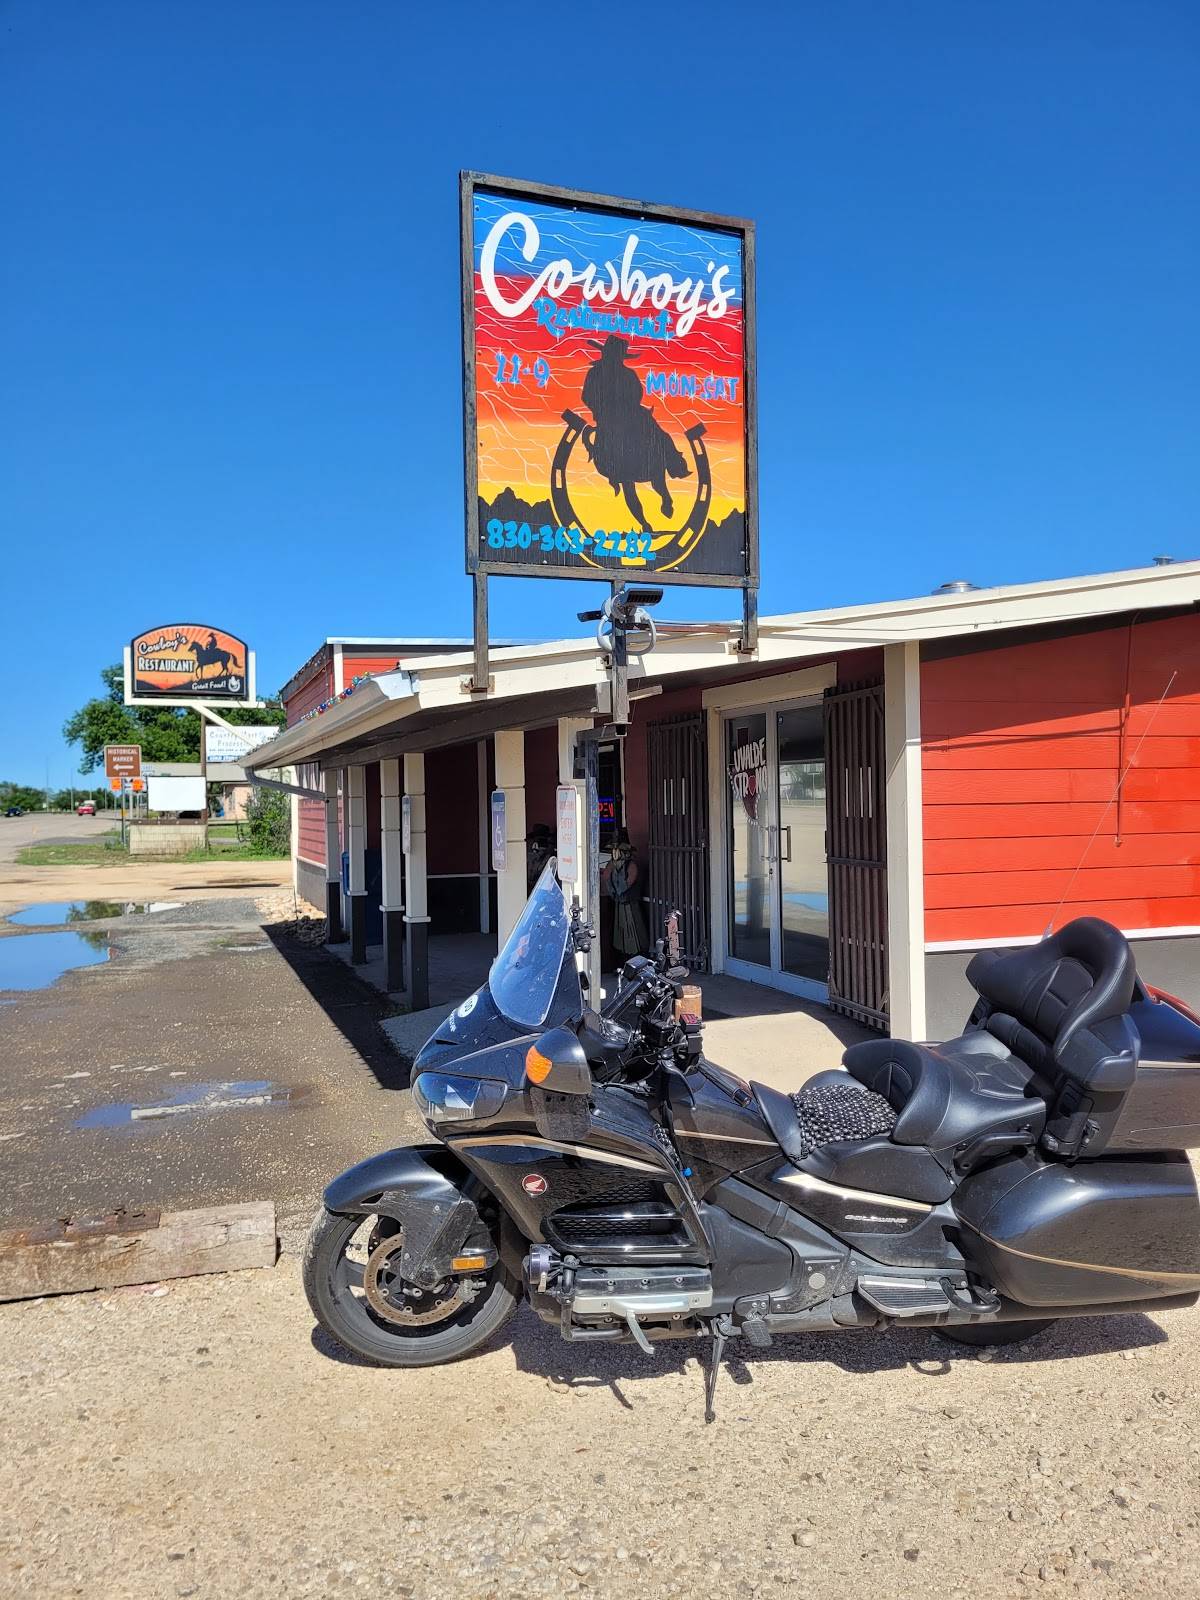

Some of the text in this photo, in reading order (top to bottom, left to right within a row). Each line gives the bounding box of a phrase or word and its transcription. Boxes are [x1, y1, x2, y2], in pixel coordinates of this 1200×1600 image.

[480, 212, 736, 337] Cowboy's
[532, 297, 676, 340] Restaurant
[646, 372, 739, 401] MON-SAT
[487, 518, 656, 561] 830-363-2282
[139, 632, 188, 655] Cowboy's
[138, 656, 195, 672] RESTAURANT
[733, 737, 766, 773] UVALDE
[597, 801, 615, 818] PEN
